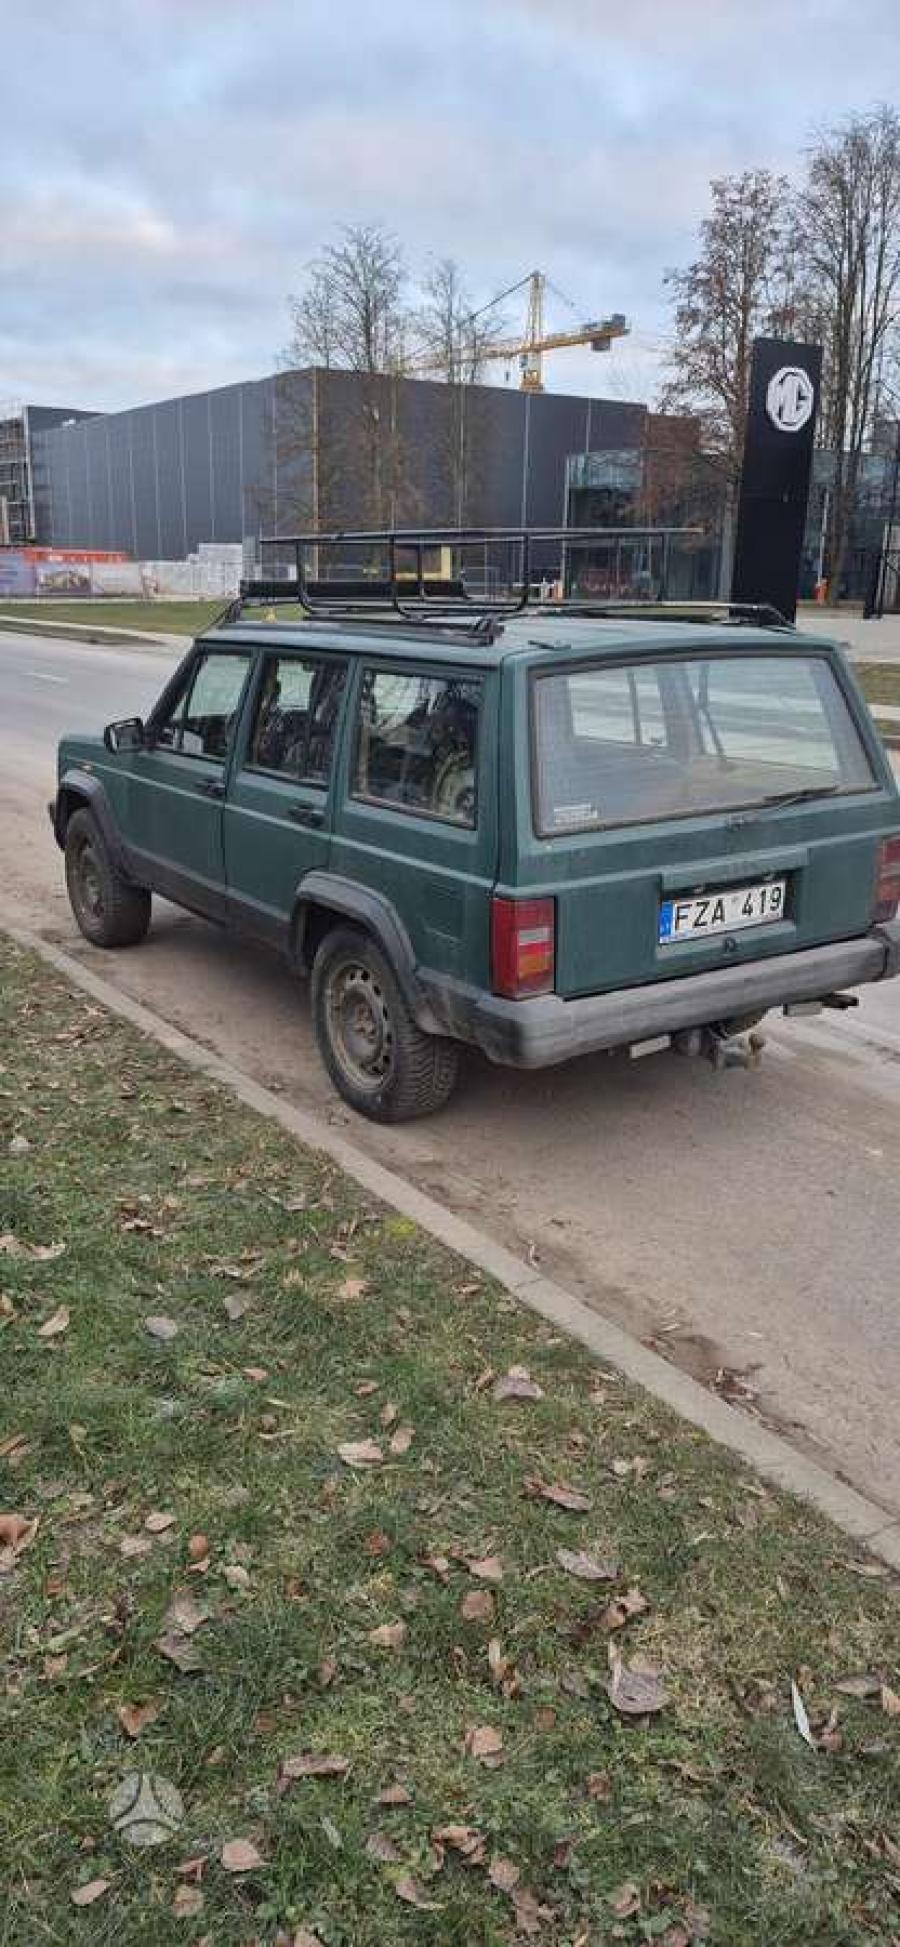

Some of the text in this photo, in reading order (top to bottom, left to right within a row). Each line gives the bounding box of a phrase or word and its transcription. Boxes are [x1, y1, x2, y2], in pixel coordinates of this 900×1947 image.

[769, 372, 809, 426] MG
[674, 899, 725, 931] FZA
[741, 886, 782, 916] 419
